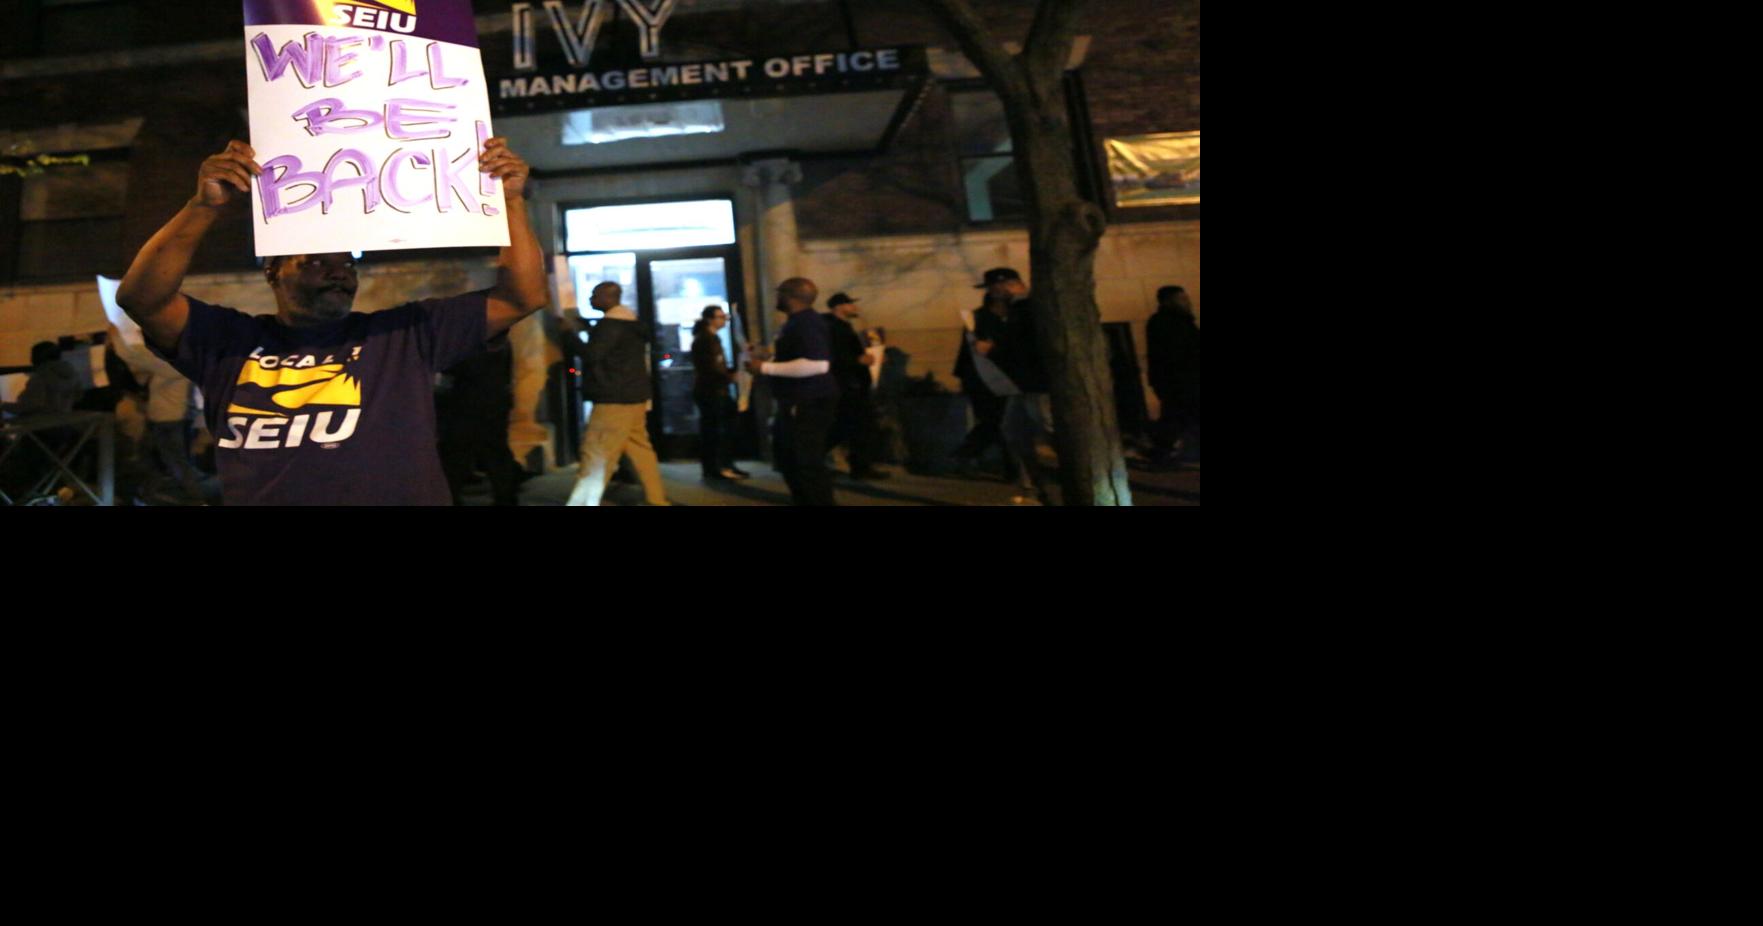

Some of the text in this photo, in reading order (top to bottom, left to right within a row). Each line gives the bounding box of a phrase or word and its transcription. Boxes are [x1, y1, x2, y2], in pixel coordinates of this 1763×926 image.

[331, 5, 416, 33] SEIU
[513, 0, 674, 70] IVY
[251, 31, 469, 90] WE'LL
[499, 49, 899, 99] MANAGEMENT OFFICE
[292, 97, 457, 141] BE
[256, 119, 500, 224] BACK!
[218, 408, 361, 450] SEIU
